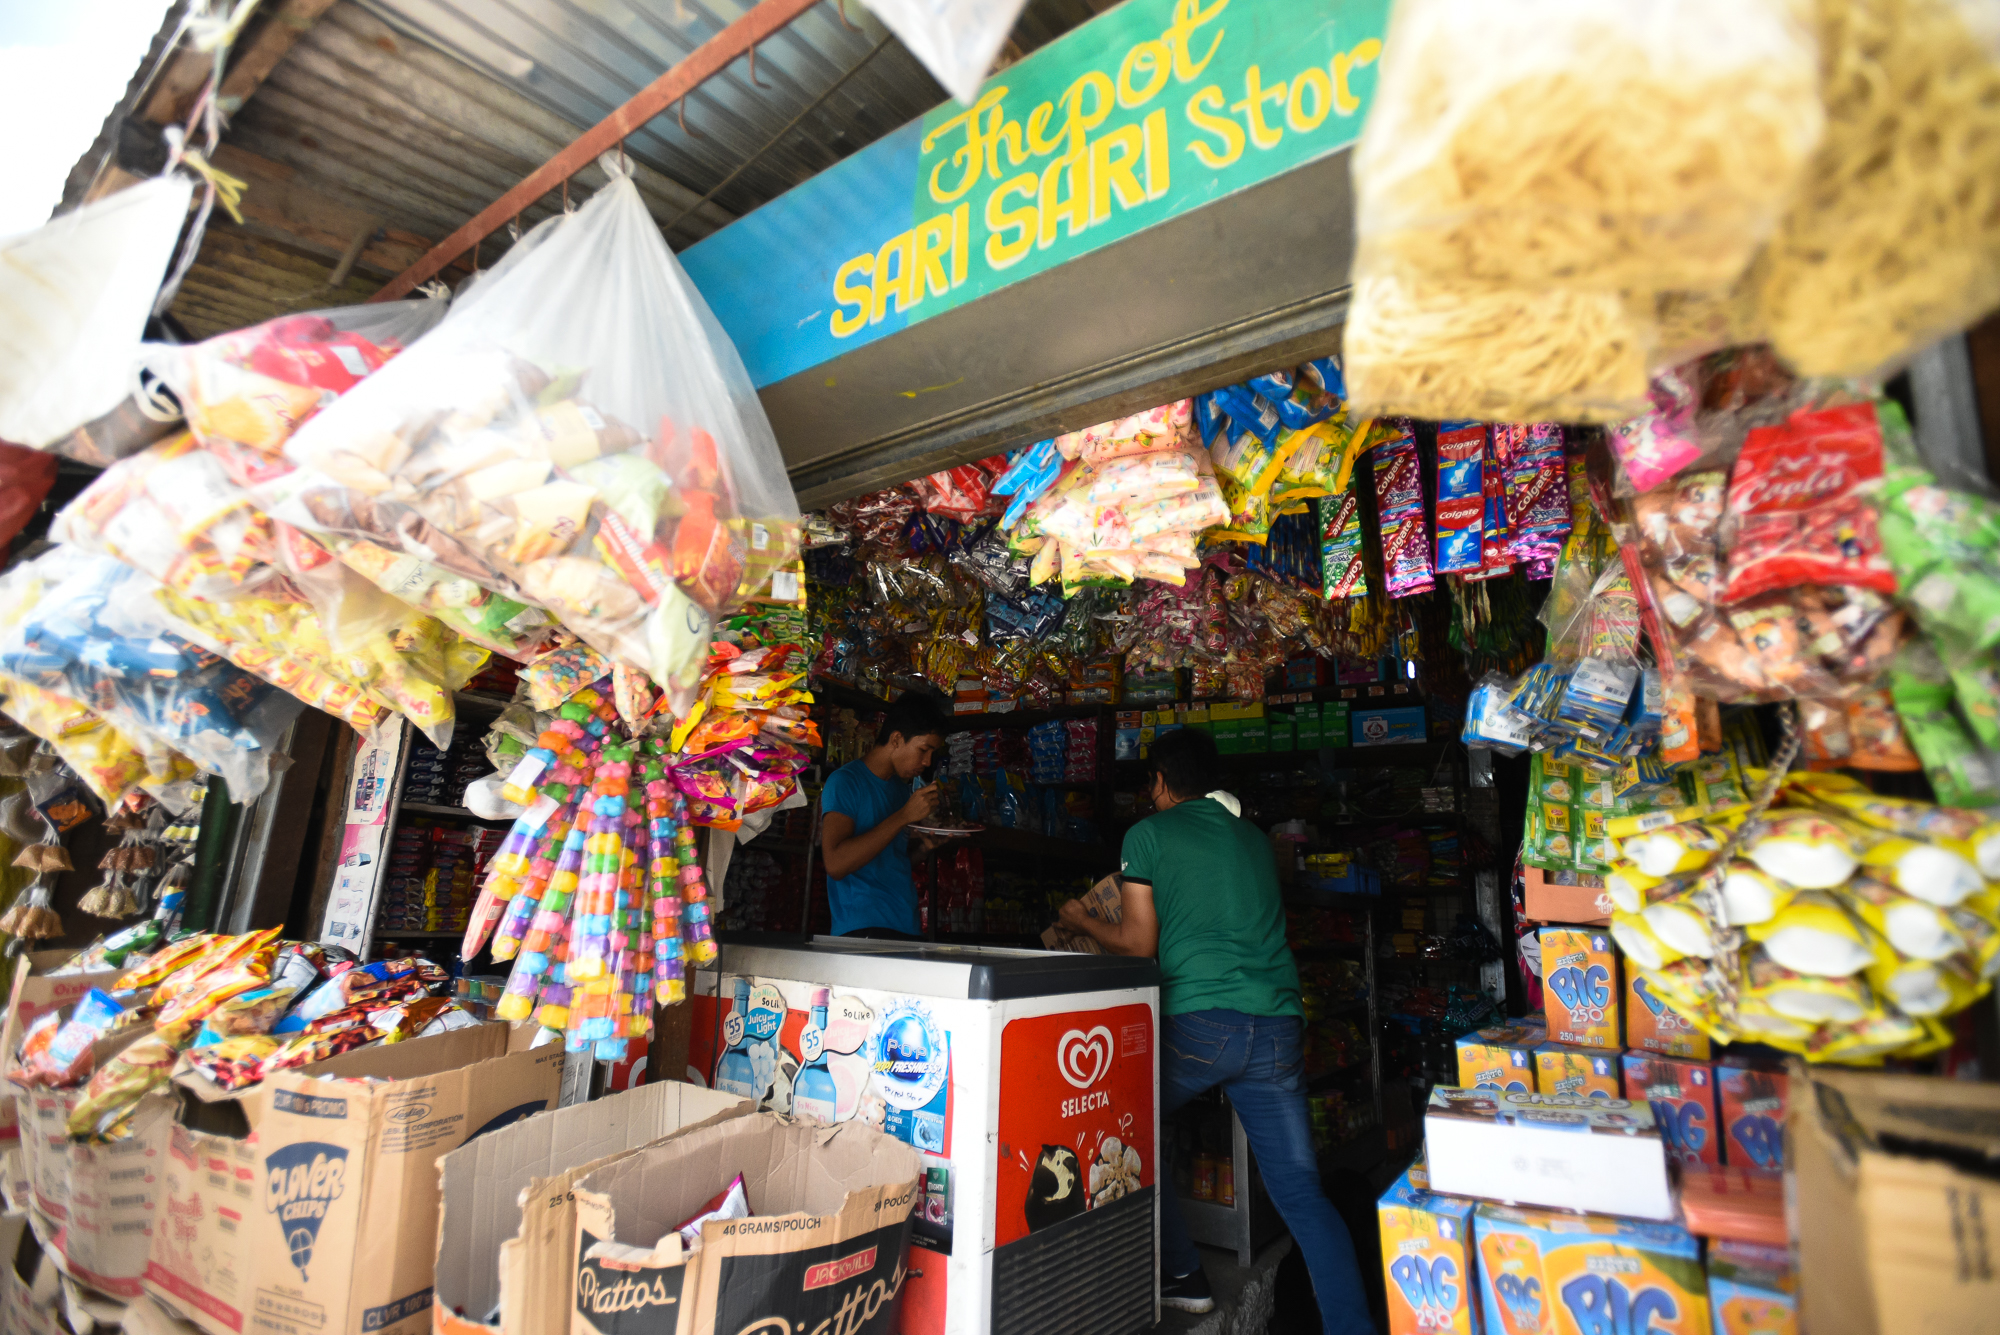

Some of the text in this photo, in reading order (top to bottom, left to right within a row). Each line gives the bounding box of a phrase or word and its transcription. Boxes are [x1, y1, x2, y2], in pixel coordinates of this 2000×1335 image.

[829, 37, 1384, 338] SARI SARI Stor
[1440, 438, 1481, 452] Colgate
[1376, 455, 1405, 496] Colgate
[1517, 469, 1553, 512] Colgate
[1438, 507, 1480, 520] Colgate
[1385, 520, 1414, 562] Colgate
[752, 988, 777, 1000] So Nice
[1547, 964, 1610, 1011] BIG
[761, 997, 781, 1009] So Li
[747, 1013, 767, 1025] Juicy
[843, 1008, 871, 1021] So Like
[1569, 1008, 1604, 1023] 250
[1656, 1015, 1694, 1030] 250
[756, 1021, 777, 1035] Light
[1559, 1031, 1574, 1042] 250
[1575, 1032, 1585, 1043] ml
[1594, 1035, 1604, 1046] 10
[873, 1060, 943, 1074] POP! FRESHNESS!
[311, 1099, 346, 1117] PROMO
[1061, 1090, 1110, 1119] SELECTA
[411, 1114, 464, 1132] CORPORATION
[1731, 1113, 1784, 1167] BI
[265, 1152, 346, 1214] CLOVER
[282, 1199, 328, 1222] CHIPS
[549, 1194, 563, 1209] 25
[723, 1217, 821, 1236] 40 GRAMS/POUCH
[579, 1266, 677, 1314] Piattos
[1390, 1253, 1459, 1311] BIG
[1495, 1273, 1542, 1317] BIG
[1561, 1273, 1680, 1335] BIG
[1416, 1309, 1454, 1329] 250
